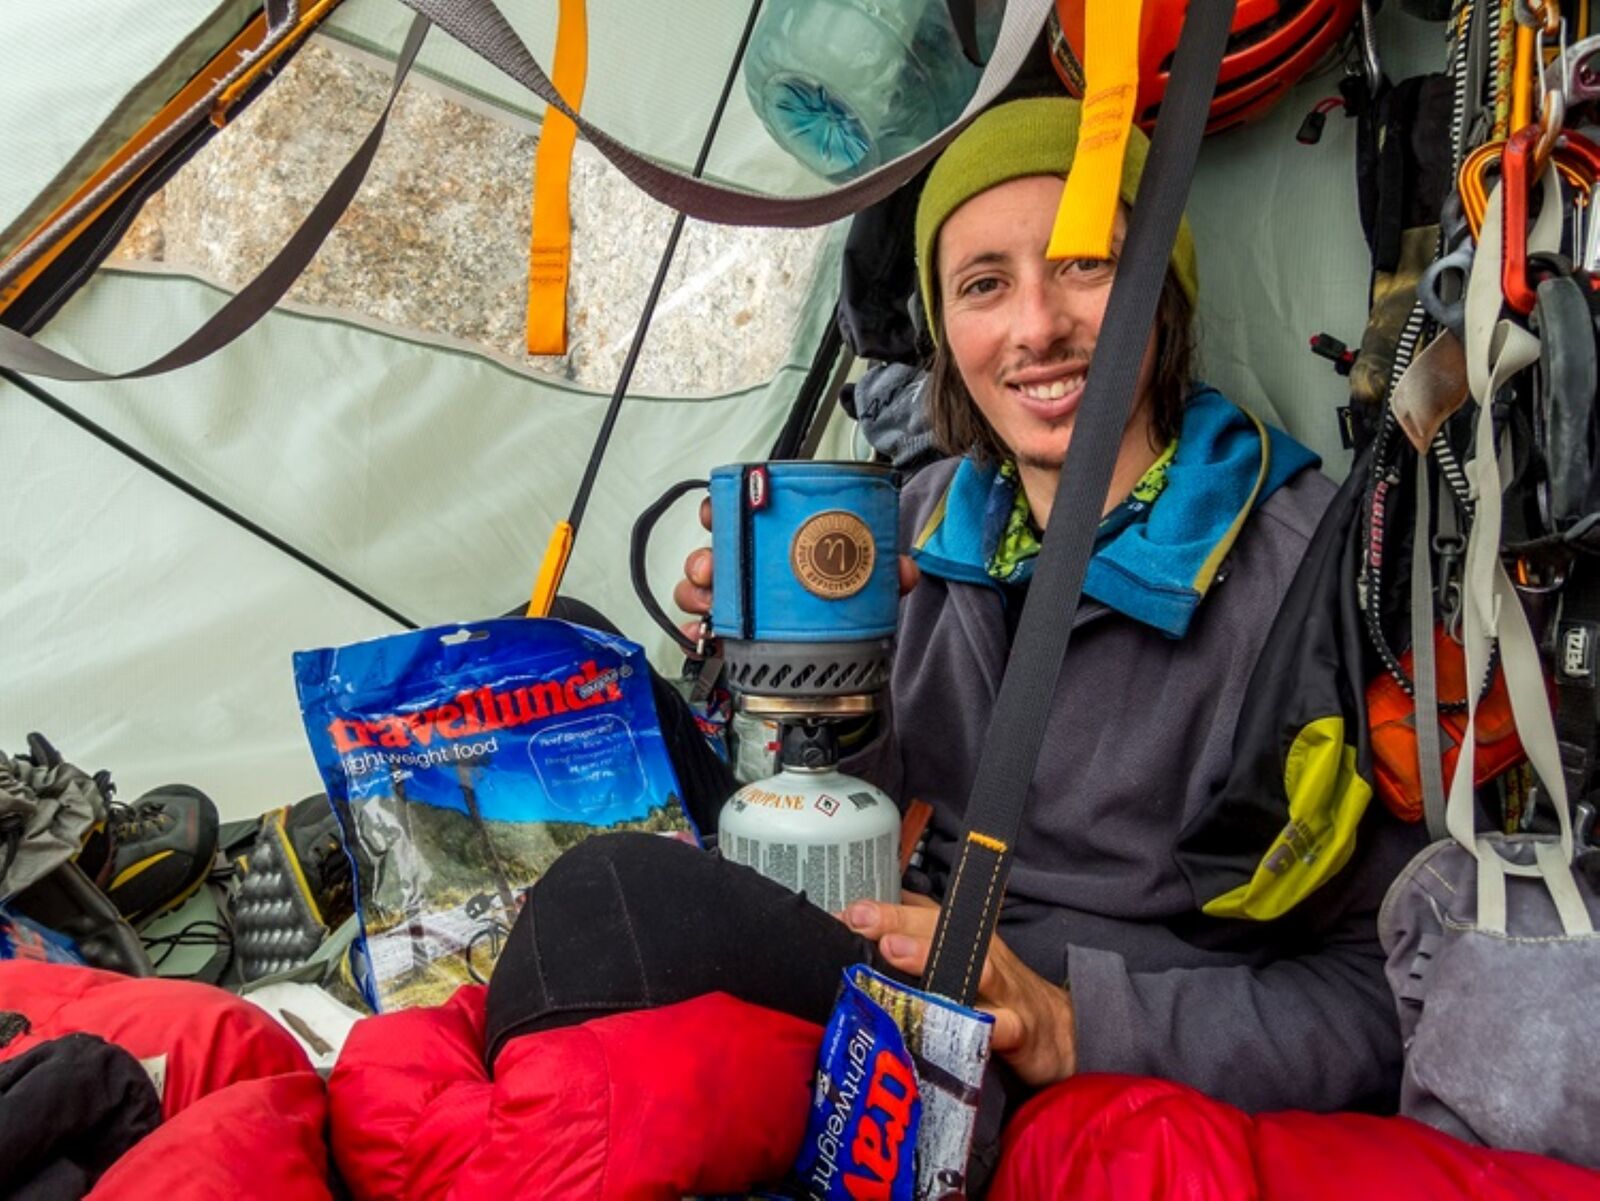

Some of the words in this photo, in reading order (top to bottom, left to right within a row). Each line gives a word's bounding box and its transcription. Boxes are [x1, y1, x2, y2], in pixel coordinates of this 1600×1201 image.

[1565, 627, 1590, 676] PETZL
[328, 659, 623, 753] travellunch
[342, 748, 451, 776] lightweight
[452, 736, 499, 760] food
[810, 1028, 876, 1191] lightweight
